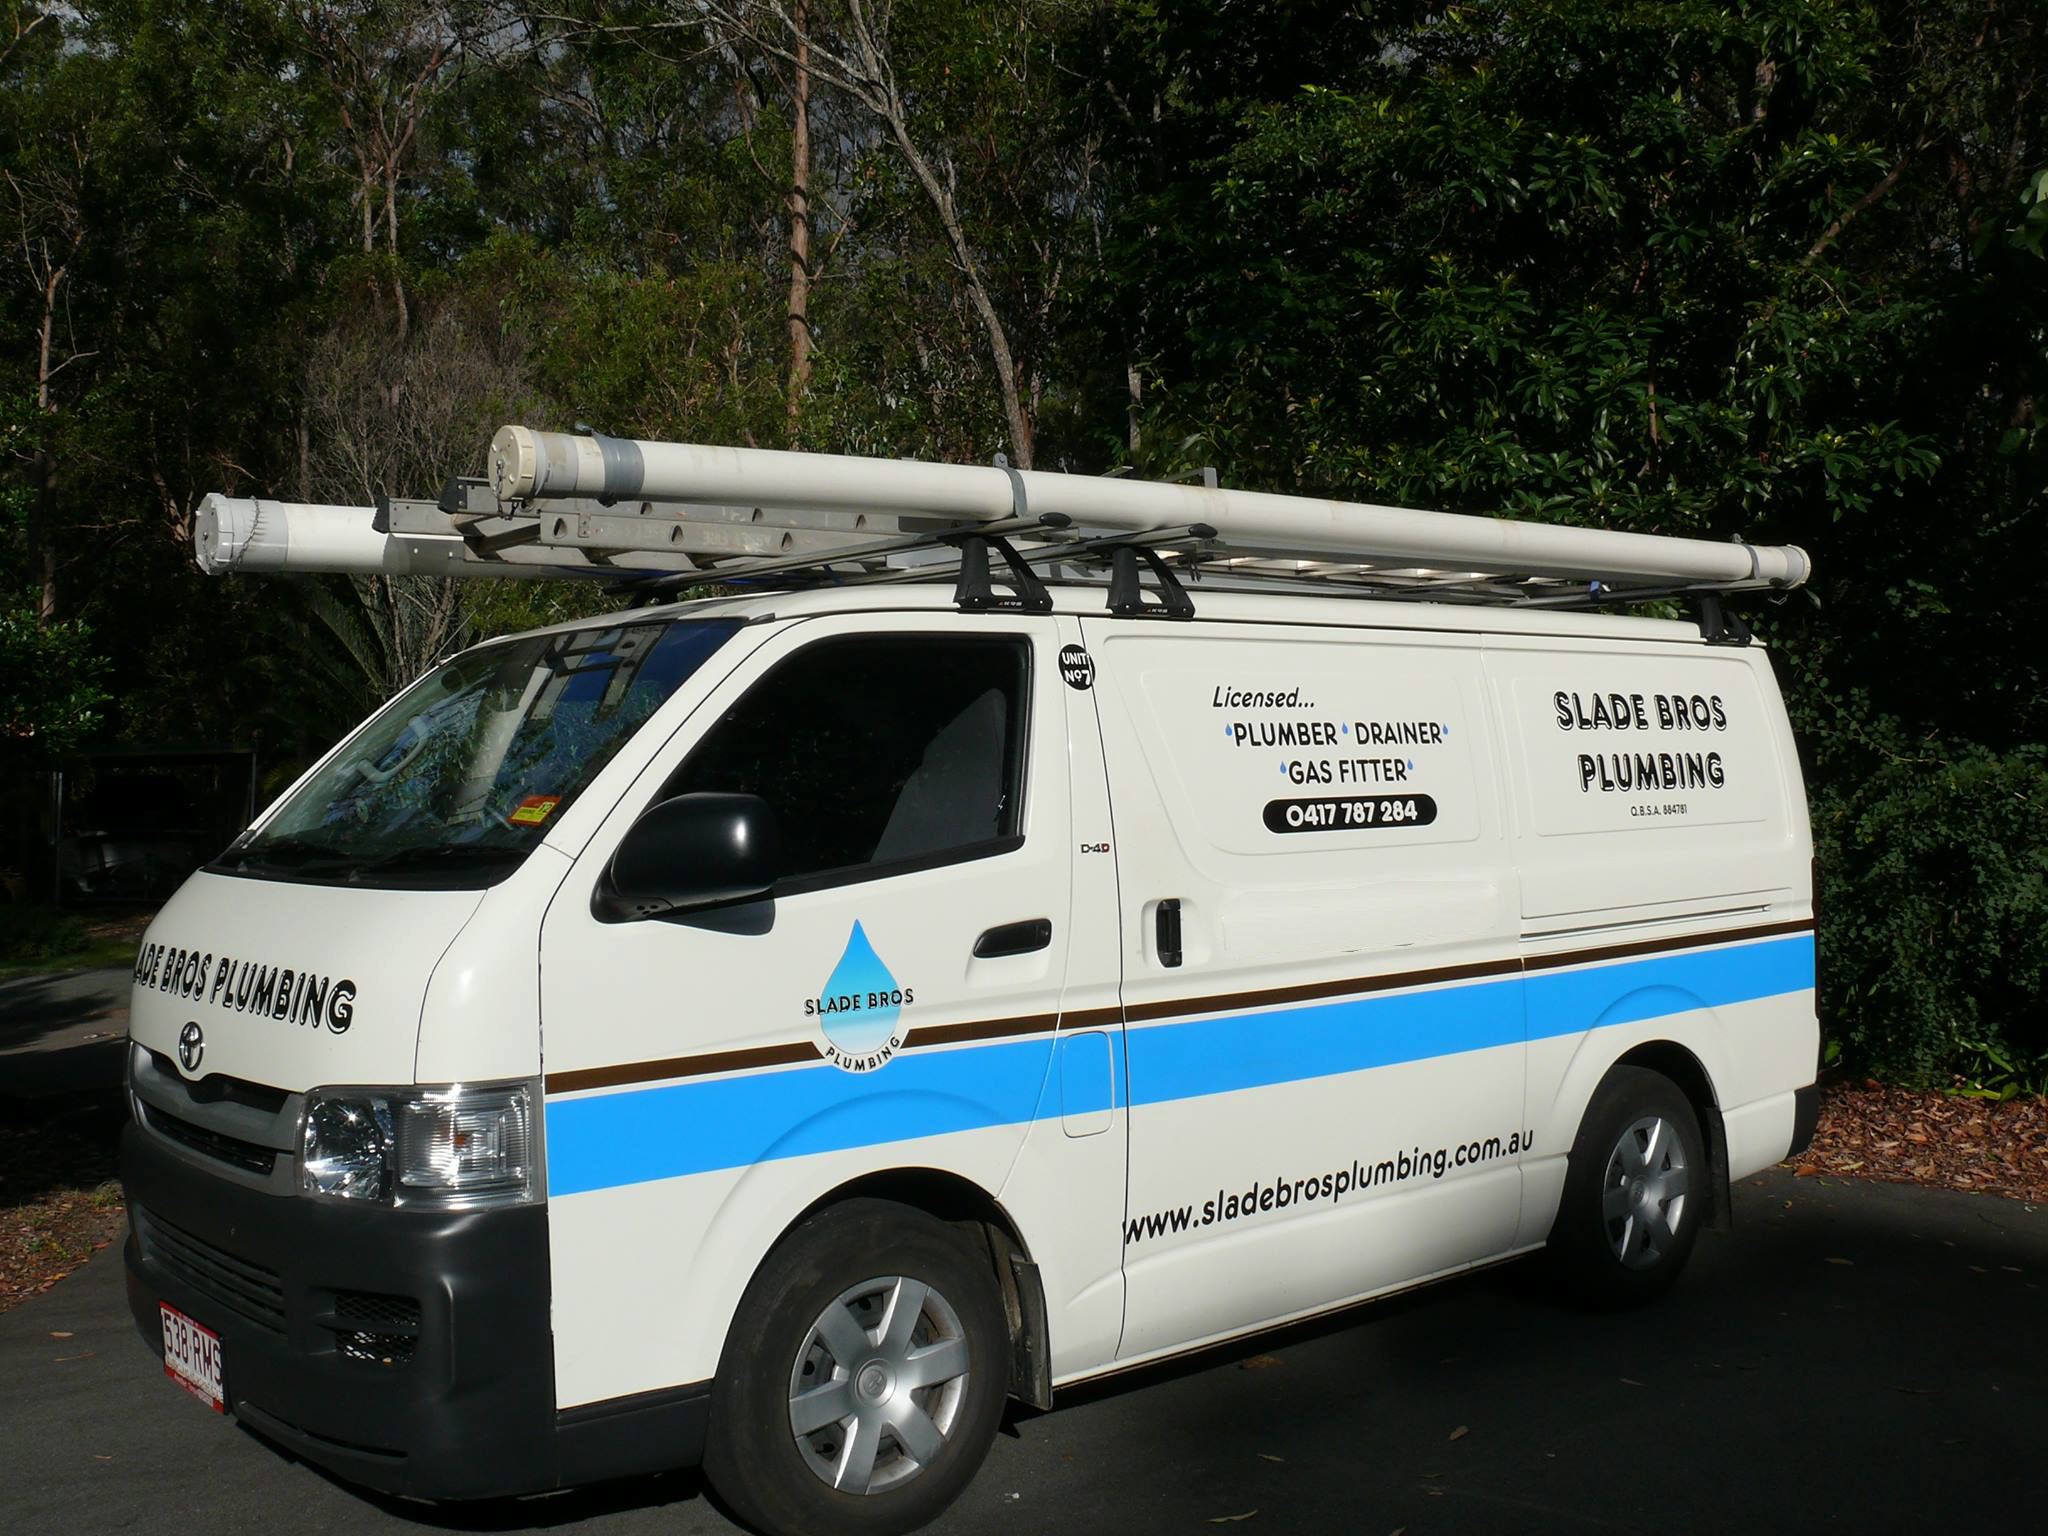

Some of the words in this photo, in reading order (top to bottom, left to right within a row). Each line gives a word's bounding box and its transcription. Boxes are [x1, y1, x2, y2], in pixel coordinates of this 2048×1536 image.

[1061, 652, 1087, 665] UNIT
[1212, 686, 1315, 708] Licensed...
[1553, 691, 1649, 731] SLADE
[1653, 694, 1727, 731] BROS
[1233, 722, 1338, 747] PLUMBER
[1354, 722, 1442, 745] DRAINER
[1288, 760, 1332, 785] GAS
[1339, 758, 1407, 783] FITTER
[1577, 752, 1724, 793] PLUMBING
[1286, 804, 1336, 827] 0417
[1341, 802, 1375, 824] 787
[1380, 800, 1418, 822] 284
[160, 948, 212, 1002] BROS
[209, 957, 357, 1034] PLUMBING
[804, 994, 861, 1015] SLADE
[868, 988, 914, 1010] BROS
[825, 1036, 900, 1071] PLUMBING
[1122, 1129, 1534, 1245] www.sladebrosplumbing.com.au
[164, 1312, 189, 1364] 538
